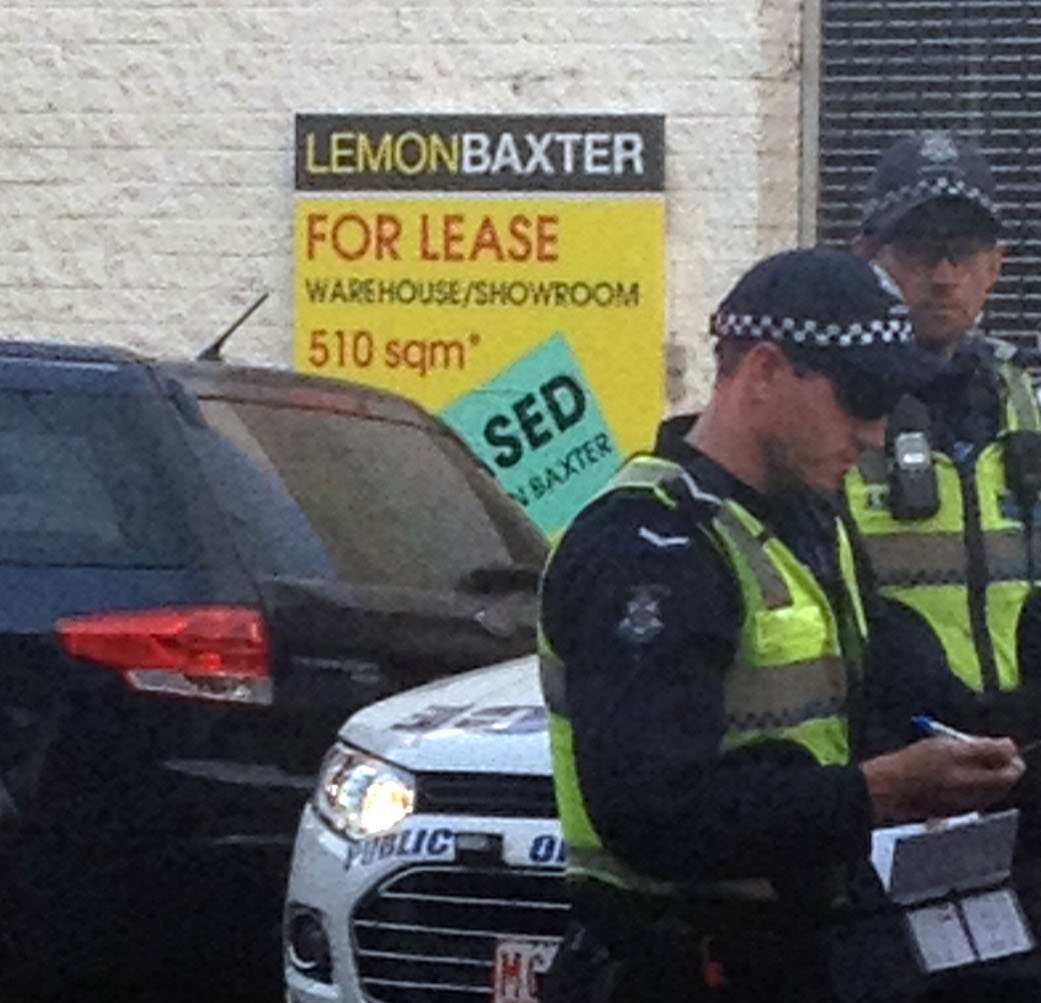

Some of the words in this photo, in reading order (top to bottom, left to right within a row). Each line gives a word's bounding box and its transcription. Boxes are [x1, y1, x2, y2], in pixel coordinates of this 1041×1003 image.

[305, 131, 645, 175] LEMONBAXTER
[307, 213, 401, 262] FOR
[419, 214, 560, 263] LEASE
[305, 278, 640, 308] WAREHOUSE/SHOWROOM
[308, 329, 374, 369] 510
[484, 374, 587, 478] SED
[528, 431, 613, 501] BAXTER
